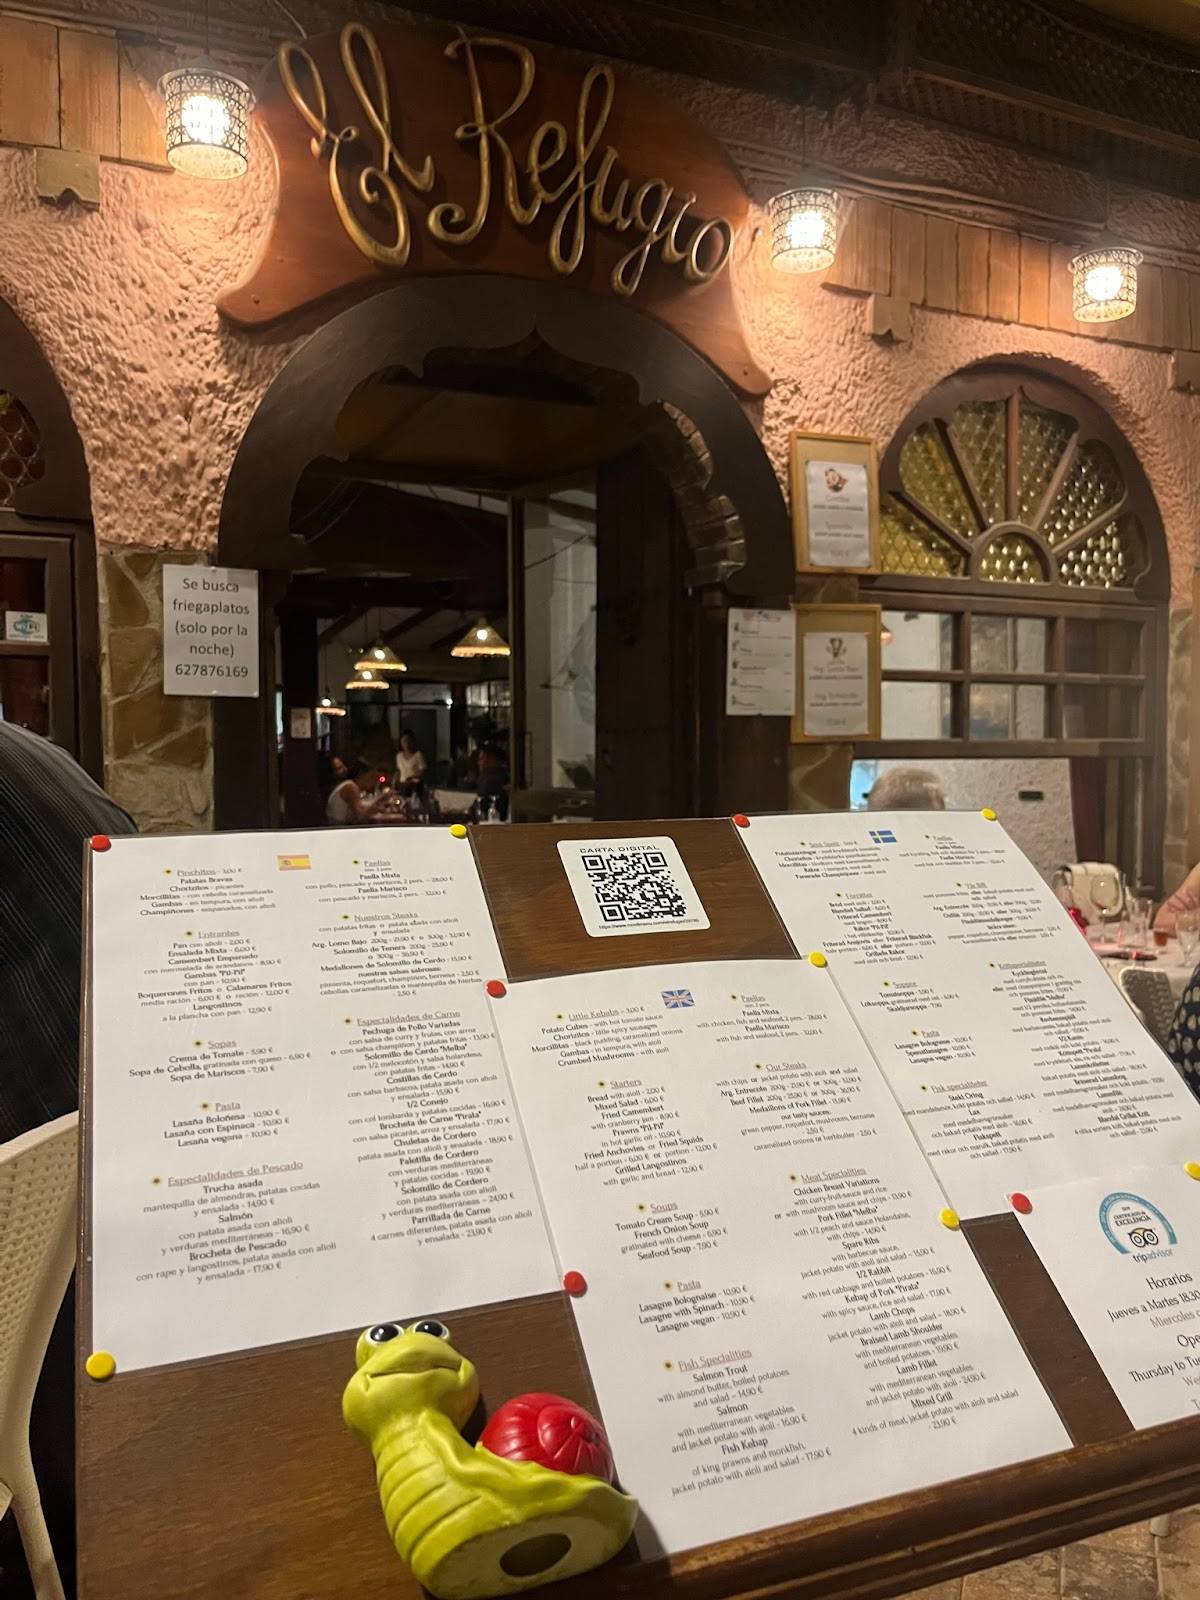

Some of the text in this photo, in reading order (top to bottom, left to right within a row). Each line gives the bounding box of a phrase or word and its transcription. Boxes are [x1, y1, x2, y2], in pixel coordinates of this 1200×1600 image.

[277, 22, 733, 297] El Refugio
[183, 578, 239, 593] Se busca
[173, 598, 250, 616] friegaplatos
[175, 621, 248, 638] (solo por la
[189, 643, 234, 657] noche)
[175, 664, 249, 678] 627876169
[167, 955, 215, 965] Camembert
[168, 948, 203, 957] Ensalada
[137, 990, 188, 999] Boquerones
[225, 983, 268, 992] Calamares
[192, 1001, 242, 1011] Langostinos
[361, 1027, 398, 1035] Pechuga
[407, 1023, 427, 1031] Pollo
[427, 1020, 460, 1028] Variadas
[207, 1040, 237, 1050] Sopas
[168, 1050, 244, 1063] Crema de Tomate
[557, 1051, 635, 1066] Crumbed Mushrooms
[129, 1069, 151, 1077] Sopa
[153, 1066, 164, 1074] de
[170, 1069, 245, 1082] Sopa de Mariscos
[386, 1070, 457, 1084] Costillas de Cerdo
[609, 1079, 642, 1090] Starters
[406, 1097, 448, 1108] 1/2 Conejo
[587, 1093, 608, 1102] Bread
[594, 1098, 639, 1111] Mixed Salad
[214, 1101, 240, 1112] Pasta
[601, 1104, 664, 1119] Fried Camembert
[172, 1118, 203, 1128] Lasaña
[205, 1114, 245, 1124] Boloñesa
[164, 1129, 195, 1138] Lasaña
[216, 1122, 255, 1133] Espinaca
[612, 1127, 639, 1136] Prawns
[177, 1134, 242, 1147] Lasaña vegana
[393, 1130, 477, 1147] Chuletas de Cordero
[584, 1149, 604, 1159] Fried
[606, 1145, 645, 1157] Anchovies
[658, 1138, 678, 1148] Fried
[678, 1135, 704, 1146] Squids
[167, 1160, 303, 1187] Especialidades de Pescado
[614, 1158, 687, 1174] Grilled Langostinos
[202, 1178, 263, 1194] Trucha asada
[400, 1177, 488, 1194] Solomillo de Cordero
[793, 1178, 880, 1196] Chicken Breast Variations
[411, 1207, 491, 1224] Parrillada de Carne
[649, 1202, 678, 1214] Soups
[217, 1212, 253, 1223] Salmón
[615, 1212, 694, 1231] Tomato Cream Soup
[633, 1220, 709, 1239] French Onion Soup
[189, 1238, 287, 1261] Brocheta de Pescado
[841, 1236, 880, 1251] Spare Ribs
[637, 1245, 691, 1260] Seafood Soup
[1132, 1248, 1174, 1263] tripadvisor
[855, 1265, 891, 1278] 1/2 Rabbit
[676, 1279, 702, 1293] Pasta
[1145, 1273, 1193, 1290] Horarios
[638, 1292, 716, 1312] Lasagne Bolognaise
[844, 1286, 895, 1303] Kebap of Pork
[638, 1300, 725, 1324] Lasagne with Spinach
[868, 1306, 915, 1321] Lamb Chops
[1106, 1306, 1140, 1323] Jueves
[1140, 1304, 1148, 1312] a
[1146, 1297, 1179, 1311] Martes
[655, 1315, 715, 1333] Lasagne vegan
[859, 1322, 943, 1346] Braised Lamb Shoulder
[677, 1349, 752, 1372] Fish Specialities
[895, 1358, 938, 1374] Lamb Fillet
[692, 1364, 748, 1382] Salmon Trout
[1128, 1363, 1174, 1382] Thursday
[1173, 1360, 1186, 1370] to
[910, 1391, 953, 1409] Mixed Grill
[716, 1403, 749, 1416] Salmon
[721, 1437, 768, 1455] Fish Kebap
